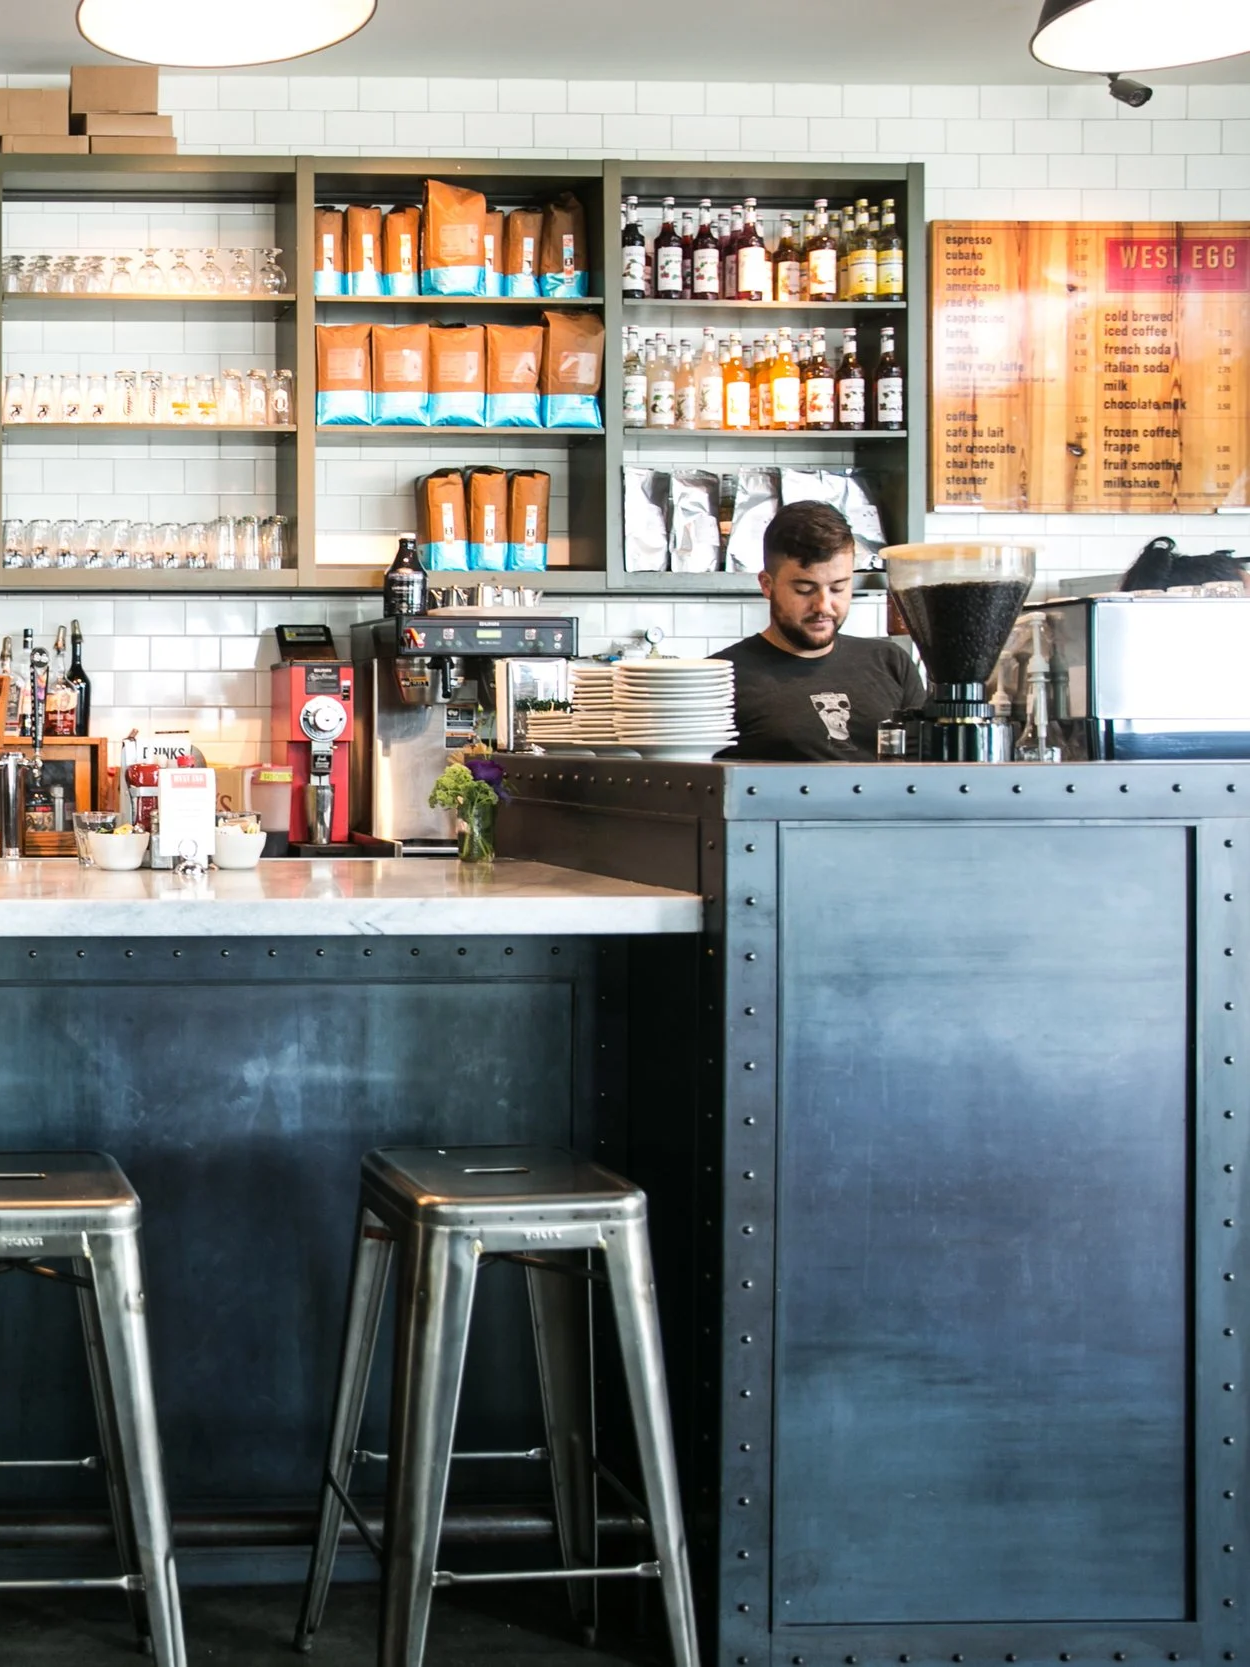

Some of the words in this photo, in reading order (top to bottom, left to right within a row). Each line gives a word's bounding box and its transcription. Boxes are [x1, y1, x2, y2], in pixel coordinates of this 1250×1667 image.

[945, 235, 992, 246] espresso
[945, 249, 983, 260] cubano
[1119, 245, 1180, 269] WEST
[1191, 245, 1236, 269] EGG
[945, 265, 986, 276] cortado
[945, 281, 1001, 292] americano
[945, 297, 963, 308] red
[966, 299, 985, 309] eye
[1104, 310, 1129, 322] cold
[1131, 310, 1174, 322] brewed
[1104, 325, 1129, 336] iced
[1131, 325, 1168, 336] coffee
[1104, 343, 1141, 355] french
[1144, 343, 1171, 355] soda
[945, 360, 972, 373] milky
[1104, 361, 1140, 373] italian
[1143, 361, 1170, 373] soda
[1103, 379, 1128, 391] milk
[1103, 397, 1162, 410] chocolate
[1162, 397, 1187, 410] milk
[945, 410, 978, 422] coffee
[971, 428, 984, 438] au
[987, 426, 1005, 438] lait
[1103, 426, 1139, 438] frozen
[1142, 426, 1179, 438] coffee
[945, 441, 962, 453] hot
[965, 442, 1017, 454] chocolate
[1103, 440, 1140, 454] frappe
[945, 457, 968, 469] chai
[970, 458, 995, 470] latte
[1103, 458, 1128, 470] fruit
[1131, 458, 1182, 471] smoothie
[945, 475, 988, 485] steamer
[1103, 476, 1160, 489] milkshake
[945, 490, 962, 501] hot
